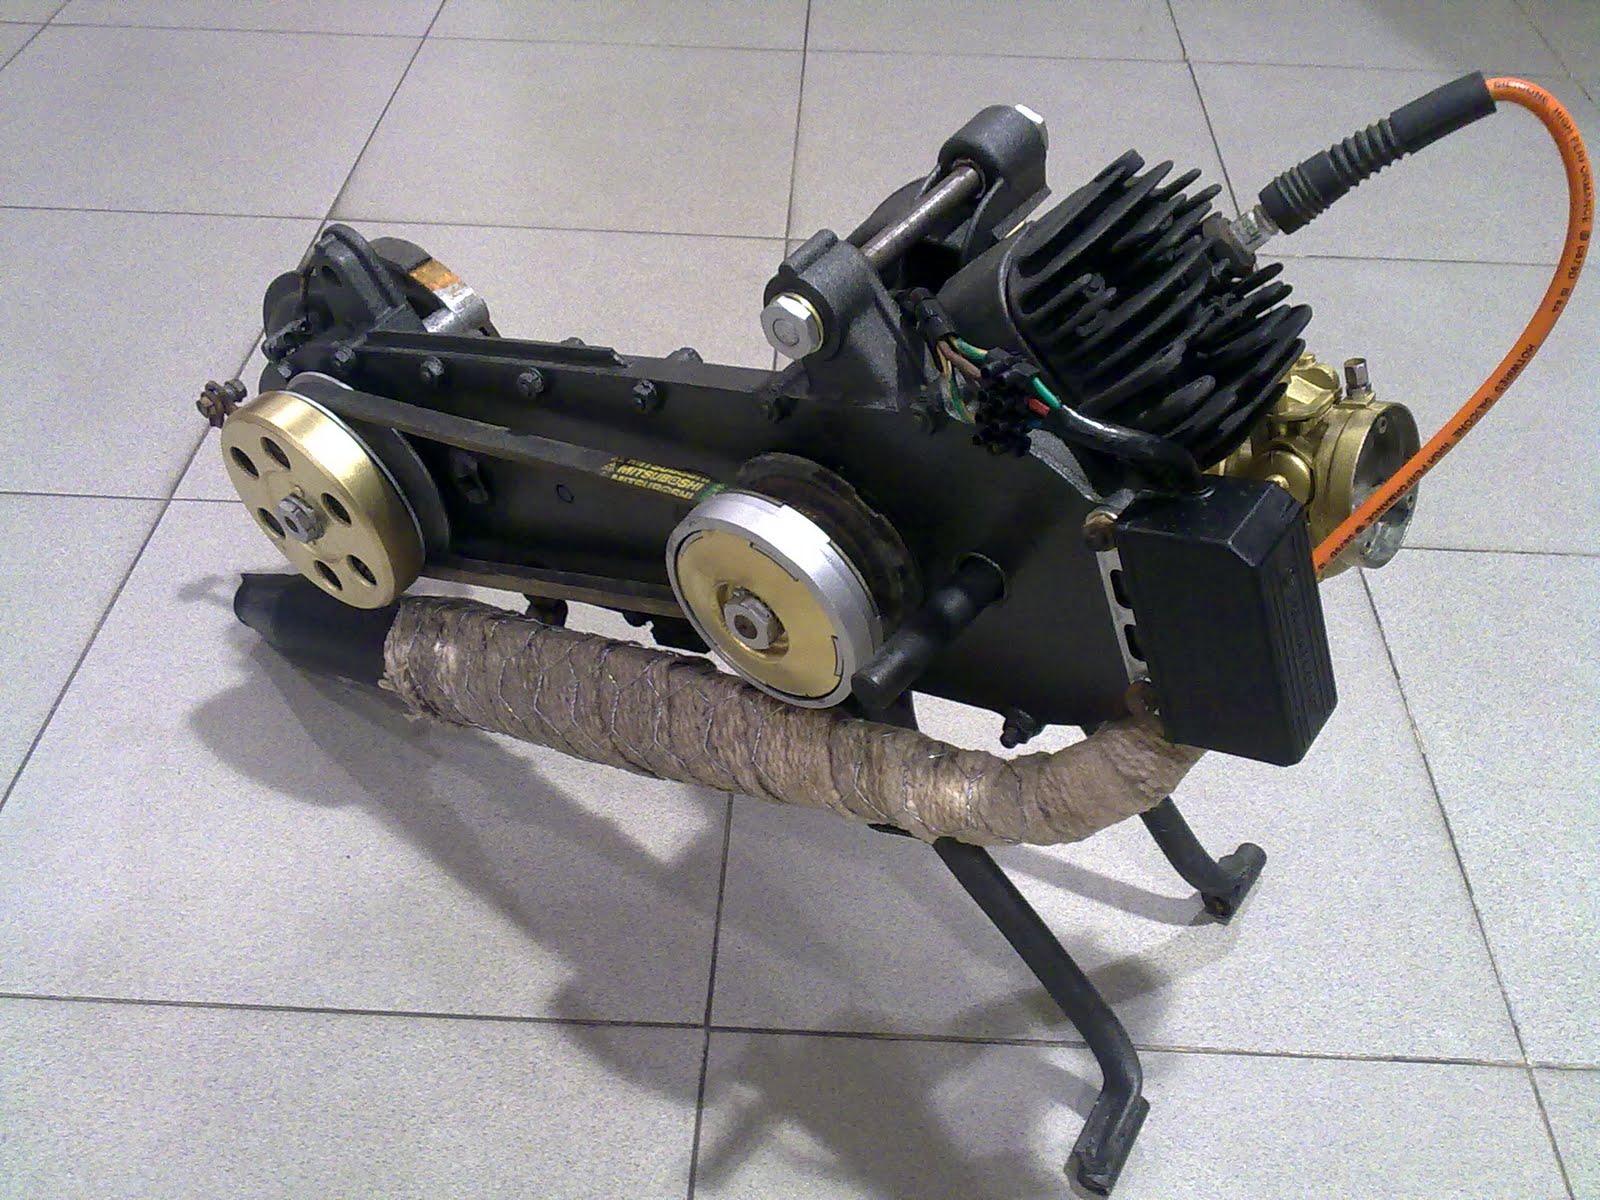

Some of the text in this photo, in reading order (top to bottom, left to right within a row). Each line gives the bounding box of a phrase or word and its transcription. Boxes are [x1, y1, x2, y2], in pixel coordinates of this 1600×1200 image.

[1428, 442, 1450, 464] HIGH
[616, 465, 705, 491] MITSUBOSHI
[1364, 464, 1427, 522] PERFORMANCE
